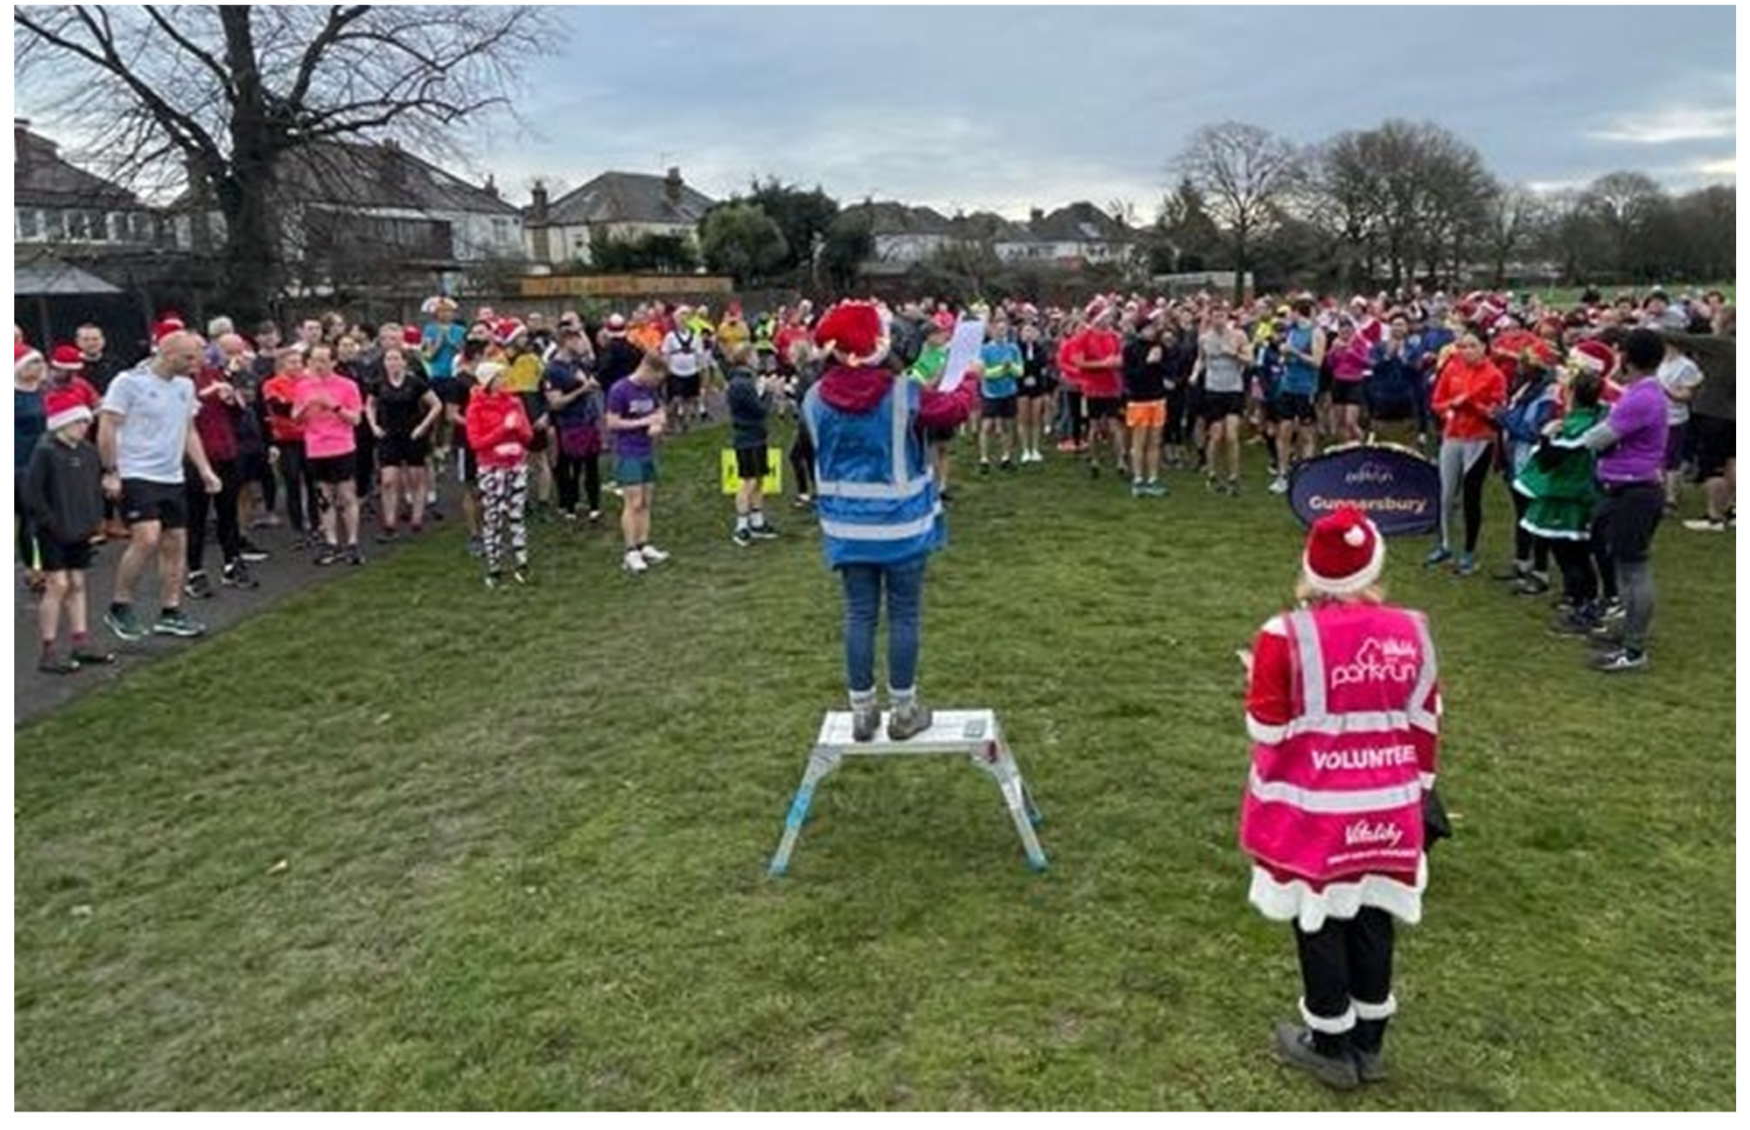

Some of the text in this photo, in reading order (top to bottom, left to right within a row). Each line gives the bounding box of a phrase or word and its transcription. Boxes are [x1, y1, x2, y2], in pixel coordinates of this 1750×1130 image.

[1308, 495, 1427, 514] Gunnersbury
[1331, 653, 1416, 689] parkrun
[1345, 820, 1403, 847] Vitality
